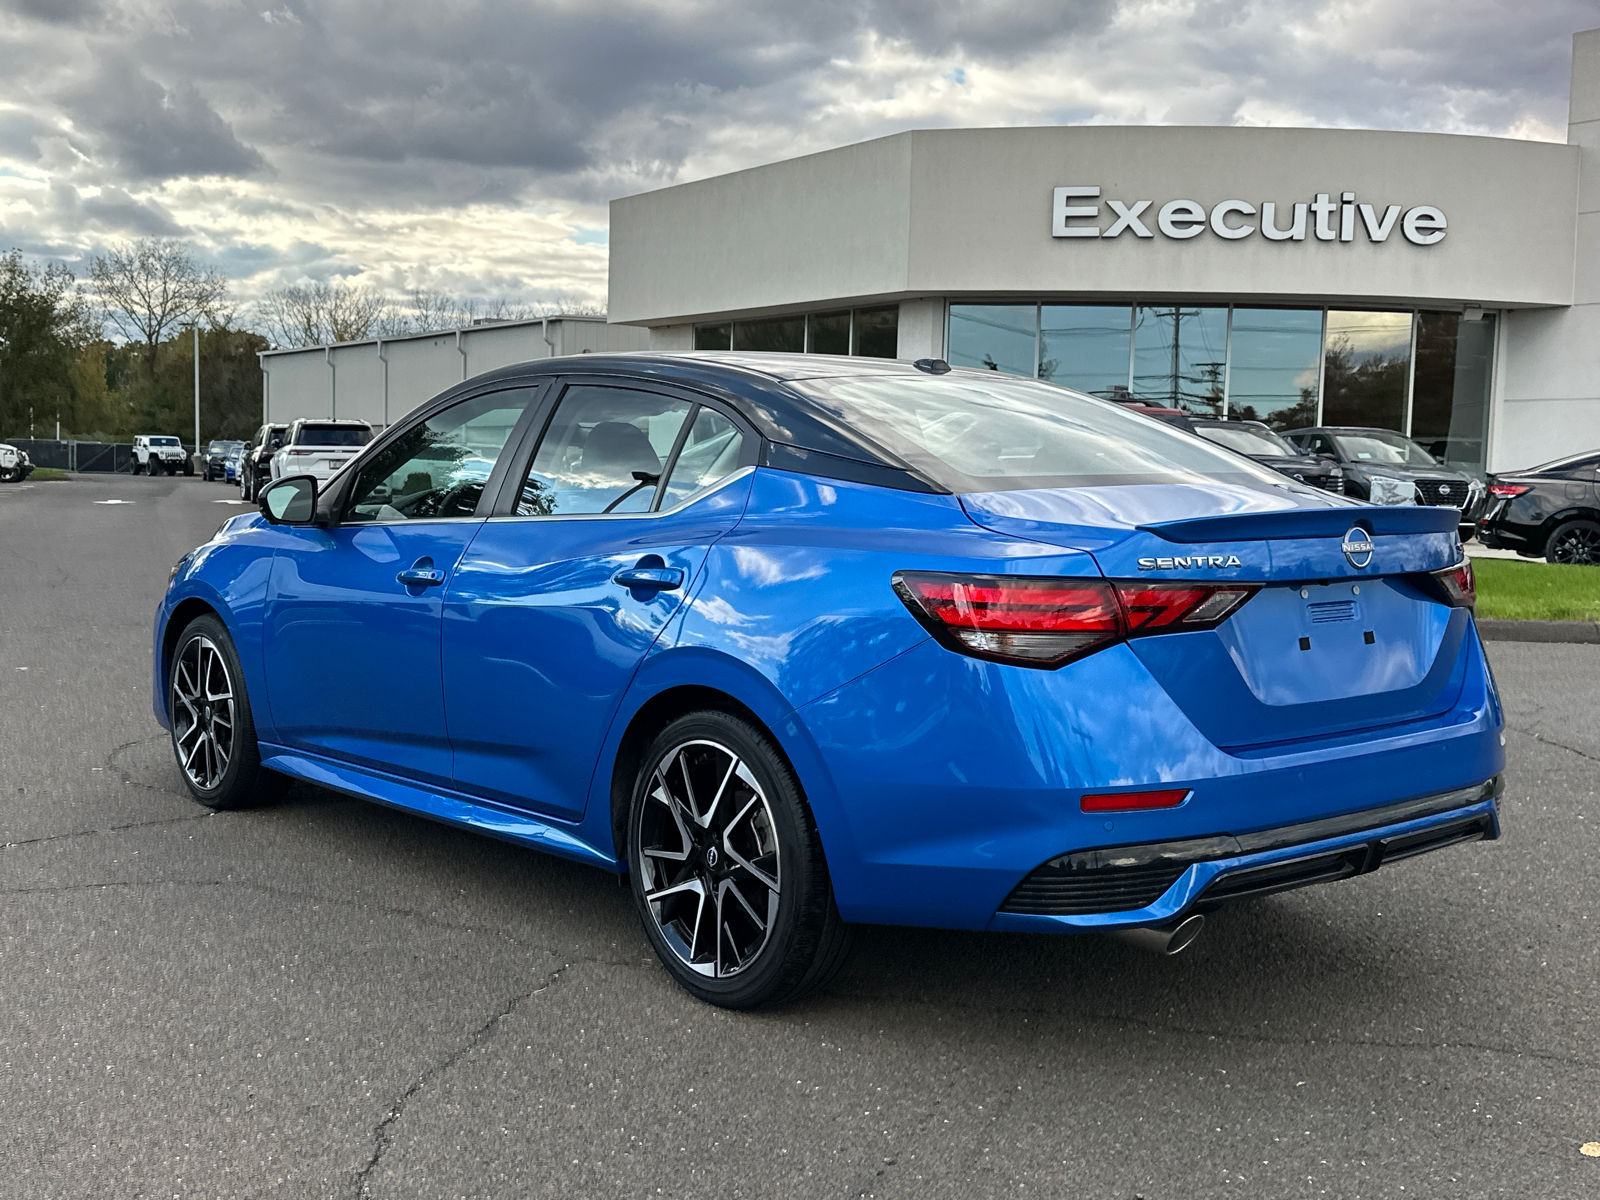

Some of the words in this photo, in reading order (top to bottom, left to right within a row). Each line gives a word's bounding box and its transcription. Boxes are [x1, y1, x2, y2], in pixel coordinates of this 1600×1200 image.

[1052, 185, 1448, 245] Executive
[1343, 542, 1375, 552] NISSAN
[1138, 555, 1242, 571] SENTRA
